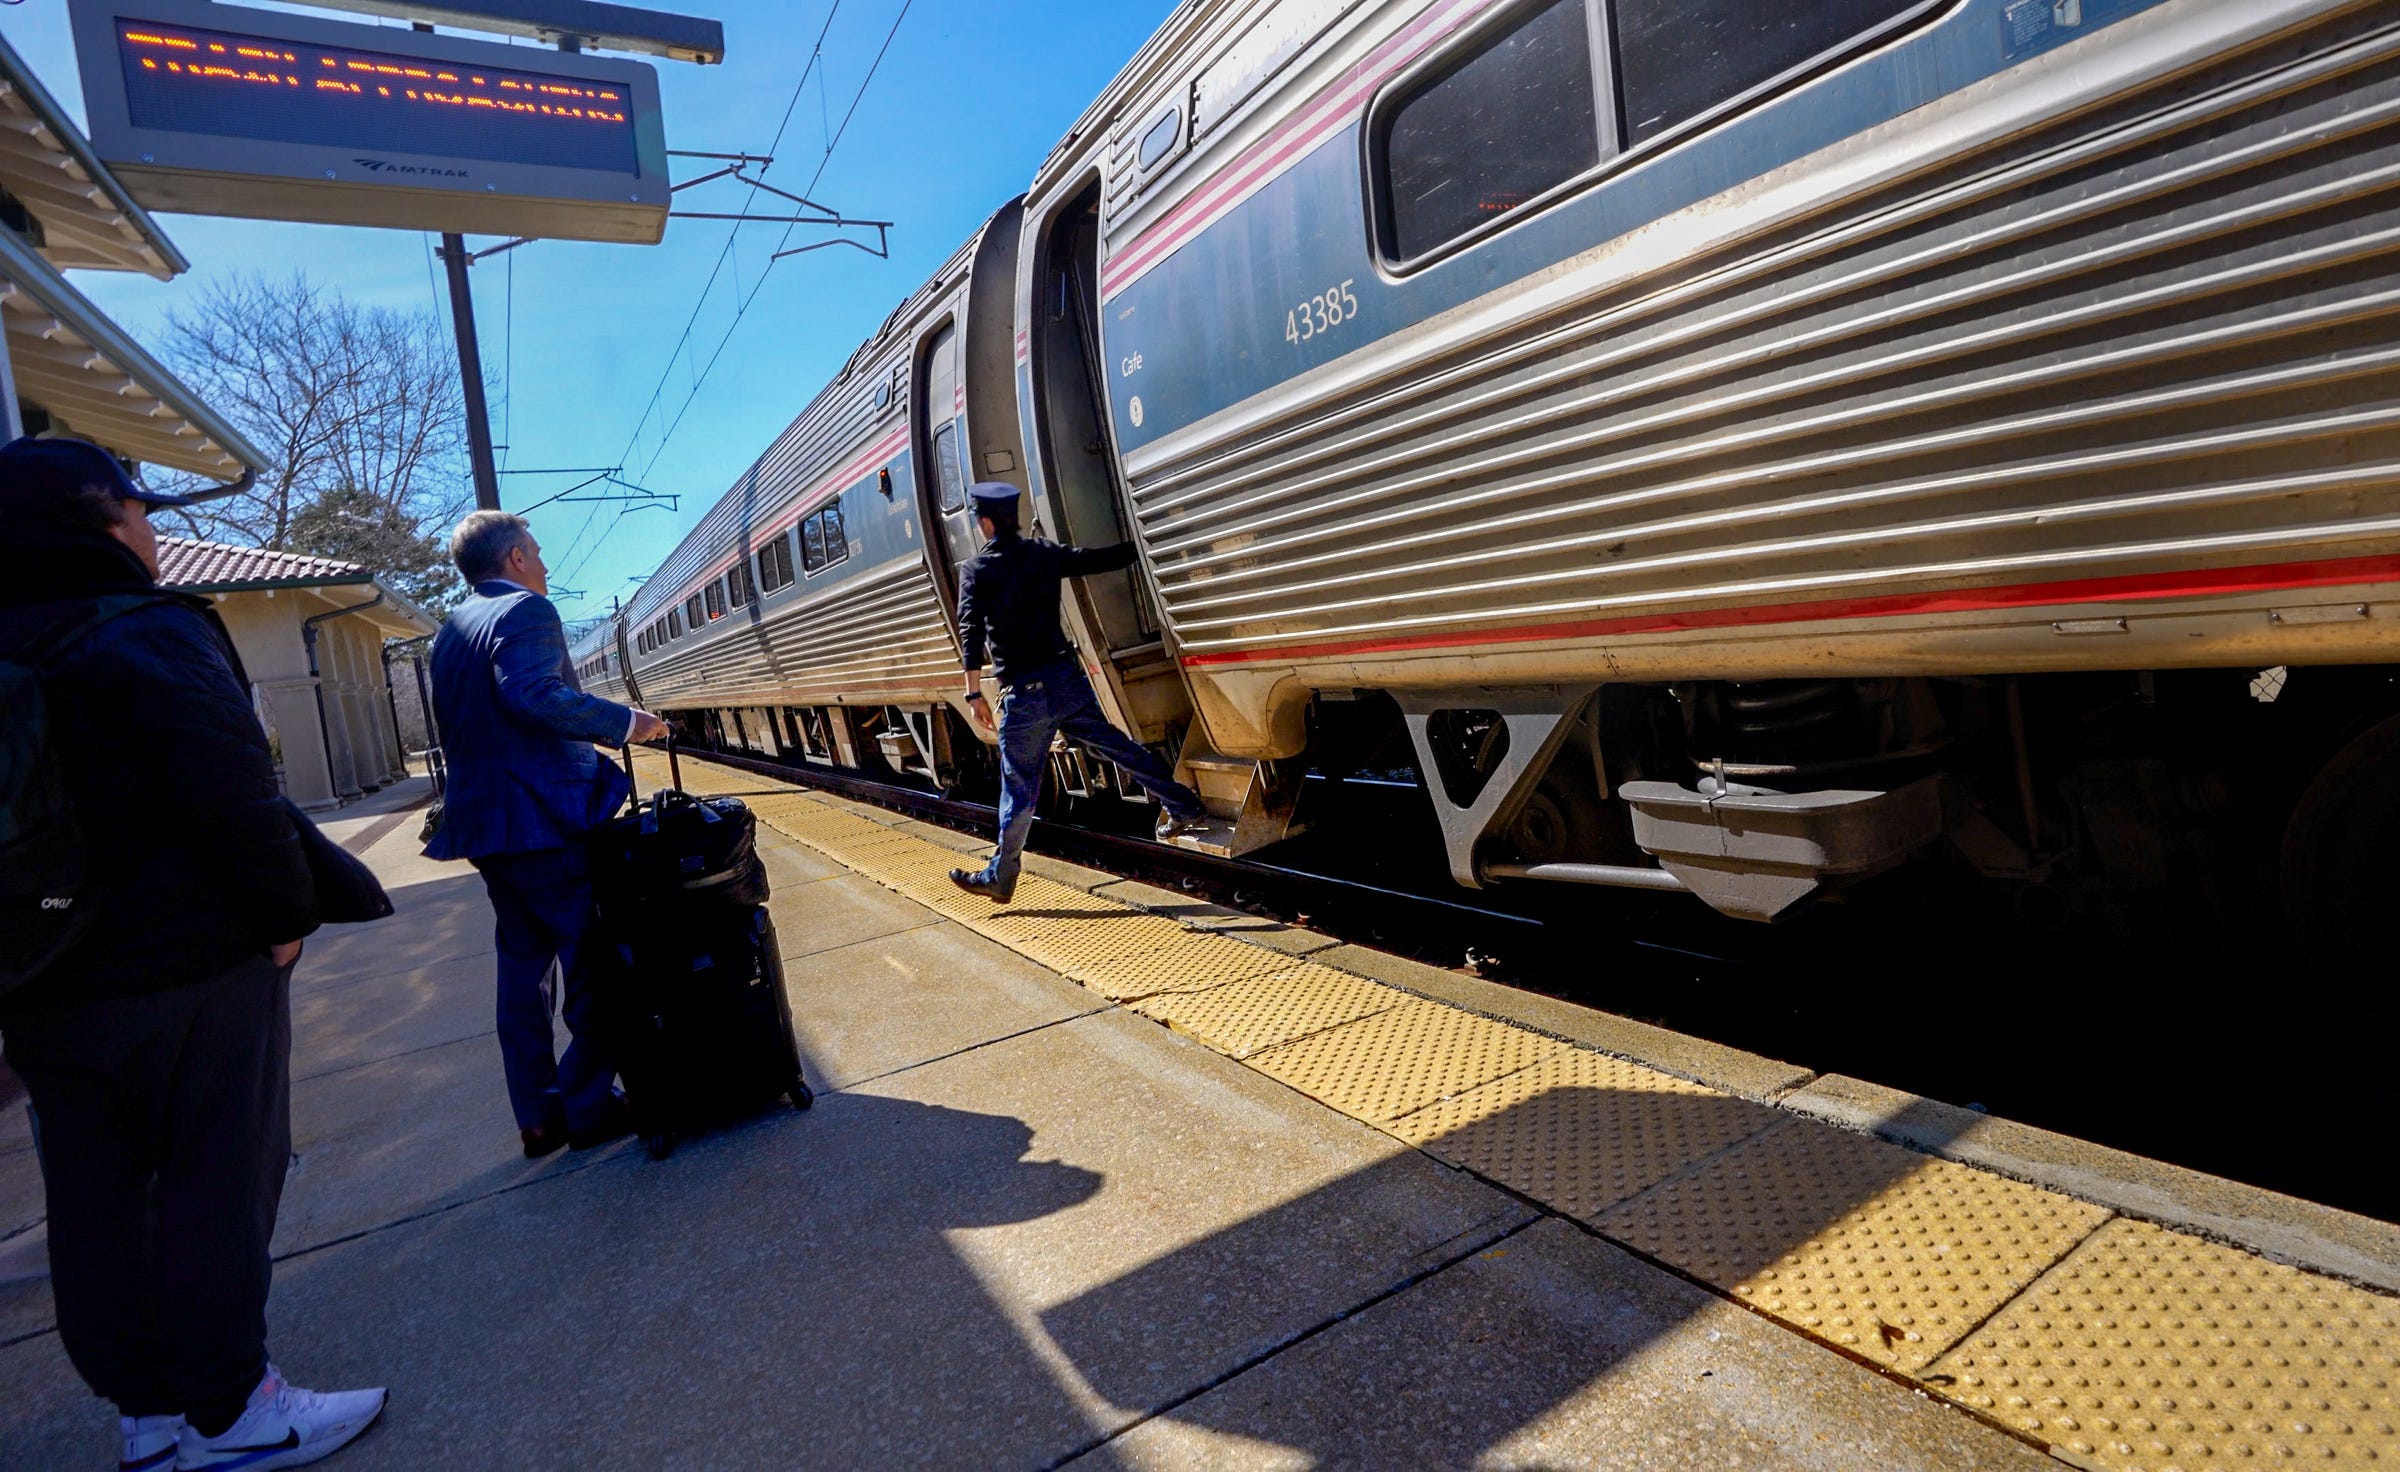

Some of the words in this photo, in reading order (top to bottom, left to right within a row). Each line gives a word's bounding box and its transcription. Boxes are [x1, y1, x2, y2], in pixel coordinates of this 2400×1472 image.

[386, 164, 470, 178] AMTRAK
[1286, 278, 1358, 345] 43385
[1121, 350, 1143, 377] Cafe
